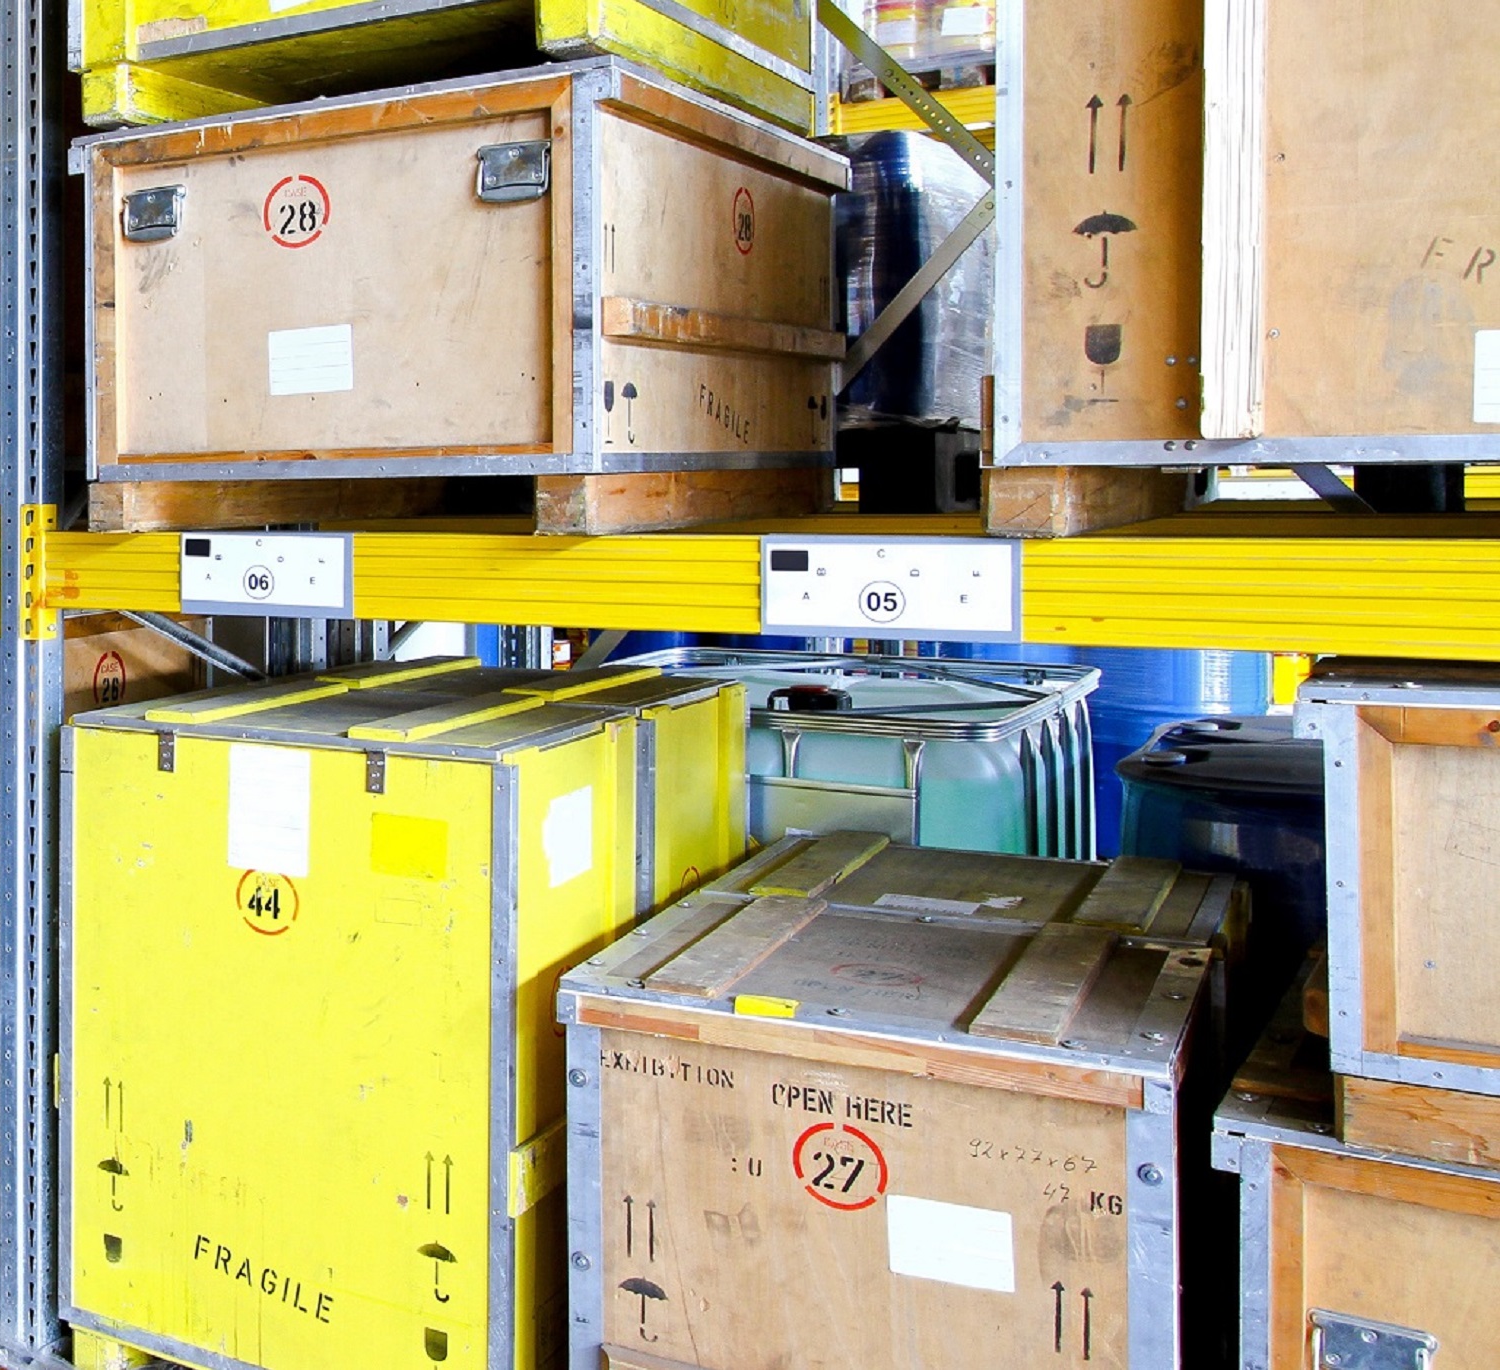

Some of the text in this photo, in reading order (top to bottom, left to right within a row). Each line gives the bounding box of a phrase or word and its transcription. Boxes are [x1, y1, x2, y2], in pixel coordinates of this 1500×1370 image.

[280, 200, 316, 234] 28
[738, 213, 751, 241] 28
[700, 384, 750, 444] FRAGILE
[877, 549, 886, 559] C
[248, 573, 269, 591] 06
[802, 591, 968, 612] A 05 E
[101, 661, 119, 674] CASE
[102, 677, 119, 702] 26
[247, 886, 280, 919] 44
[600, 1049, 734, 1089] EXHIBTION
[772, 1083, 913, 1128] OPEN HERE
[812, 1151, 865, 1193] 27
[1090, 1190, 1123, 1216] KG
[194, 1234, 335, 1324] FRAGILE
